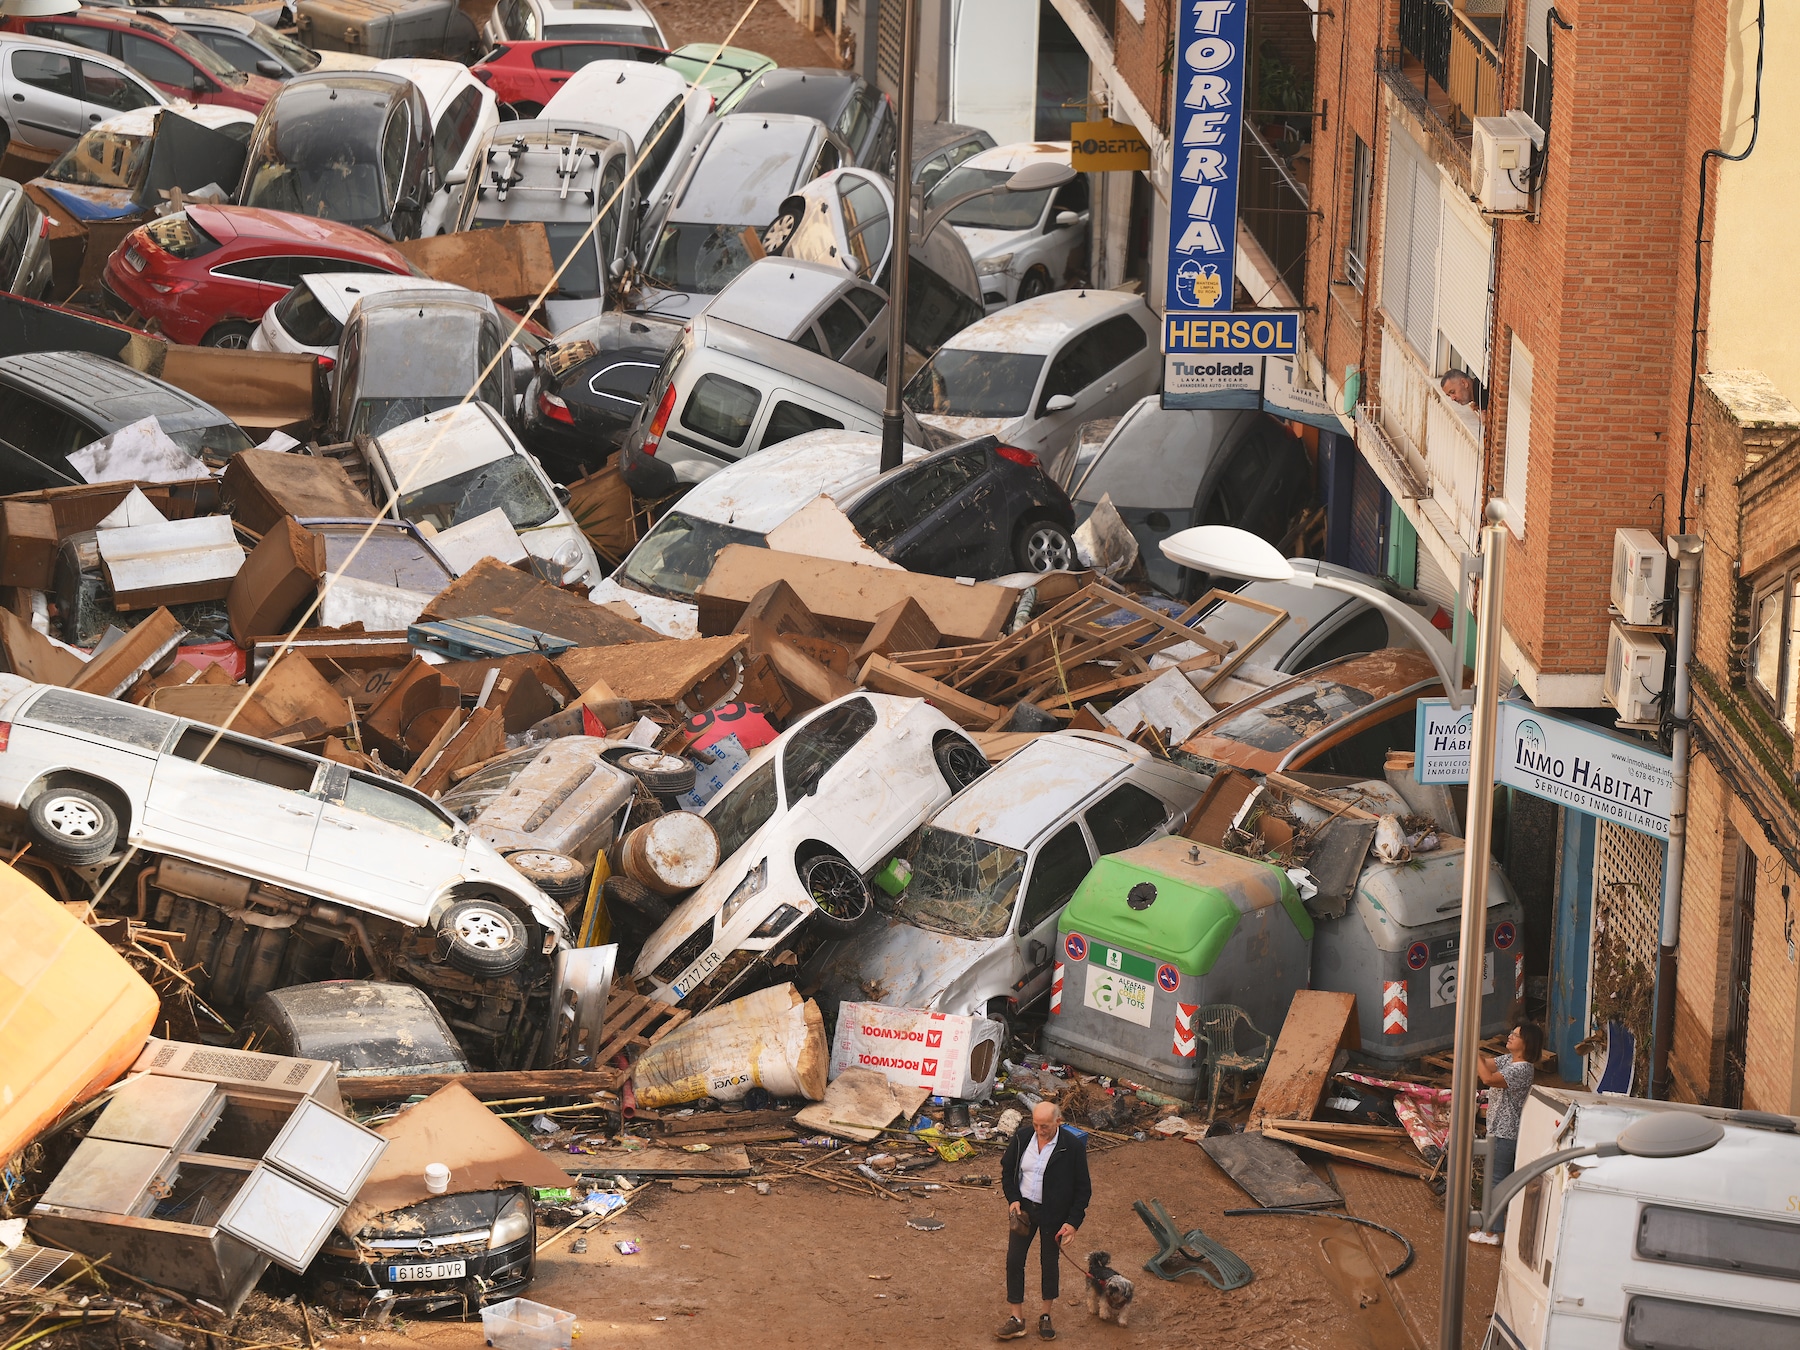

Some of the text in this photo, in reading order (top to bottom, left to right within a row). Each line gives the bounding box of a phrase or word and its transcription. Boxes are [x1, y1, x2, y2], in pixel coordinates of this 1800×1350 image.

[1169, 320, 1294, 348] HERSOL
[1172, 362, 1254, 376] Tucolada
[1292, 387, 1312, 398] LAVAR
[1428, 721, 1467, 735] INMO
[1434, 737, 1471, 751] HÁBI
[1516, 738, 1653, 808] INMO HÁBITAT
[1635, 771, 1646, 780] 678
[1648, 775, 1654, 783] 45
[1657, 778, 1664, 786] 75
[1534, 778, 1668, 833] SERVICIOS INMOBILIARIOS
[678, 952, 721, 994] 2717 LFR
[1124, 984, 1136, 993] NET
[1126, 998, 1145, 1010] TOTS
[861, 1025, 924, 1042] ROCKWOOL
[858, 1054, 920, 1071] ROCKWOOL
[713, 1074, 749, 1090] isover
[400, 1264, 462, 1280] 6185 DVR
